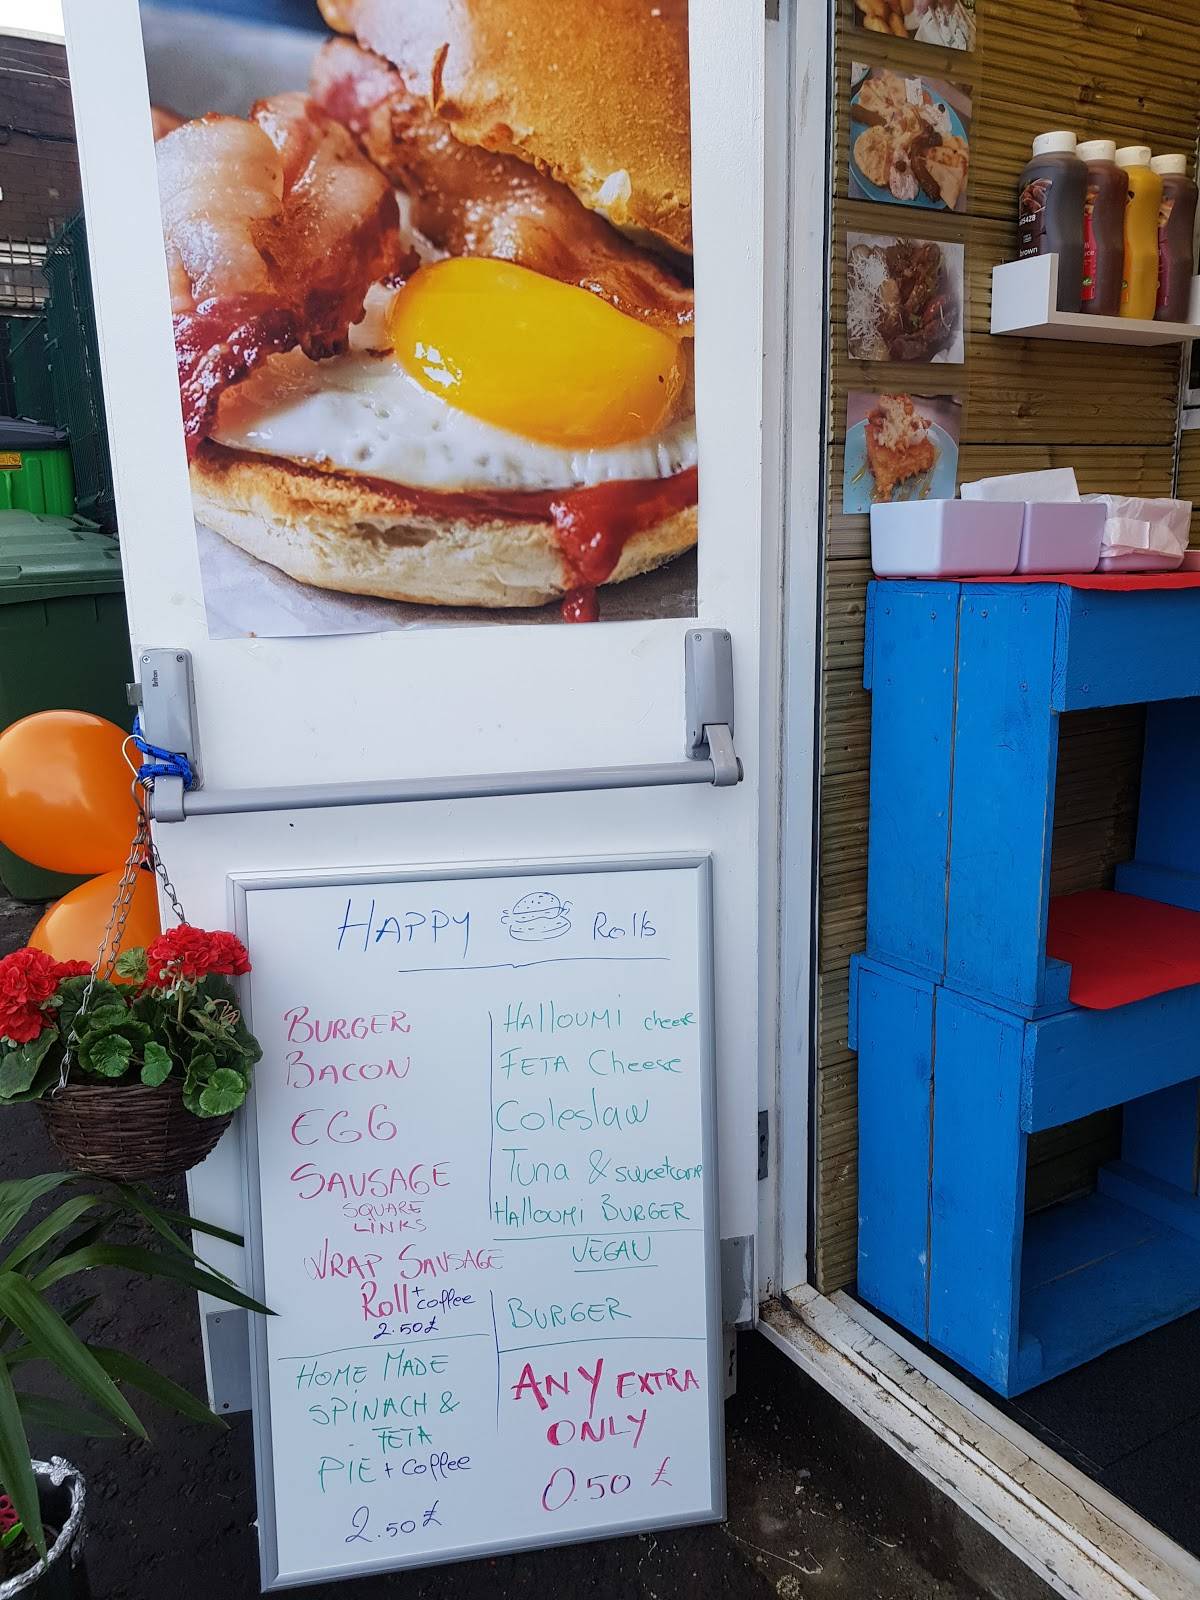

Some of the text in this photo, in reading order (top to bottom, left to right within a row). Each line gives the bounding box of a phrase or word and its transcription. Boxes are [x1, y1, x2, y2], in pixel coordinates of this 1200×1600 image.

[337, 898, 657, 958] HAPPY Rolls
[283, 1006, 411, 1043] BURGER
[285, 1050, 411, 1089] BACON
[500, 1047, 683, 1080] FETA Cheese
[291, 1103, 398, 1146] EGG
[496, 1088, 650, 1132] Coleslaw
[290, 1161, 451, 1200] SAUSAGE
[501, 1148, 570, 1187] Tuna
[588, 1149, 613, 1185] &
[342, 1200, 425, 1220] SQUARE
[600, 1193, 691, 1222] BURGER
[303, 1238, 504, 1280] WRAP SAUSAGE
[572, 1235, 652, 1263] VEGAN
[360, 1280, 410, 1321] Roll
[416, 1288, 477, 1315] coffee
[507, 1297, 633, 1330] BURGER
[296, 1347, 449, 1390] HOME MADE
[439, 1390, 461, 1414] &
[510, 1357, 700, 1420] ANY EXTRA
[371, 1425, 433, 1455] FETA
[546, 1408, 648, 1449] ONLY
[317, 1455, 377, 1494] PIE
[541, 1466, 632, 1512] 0.50
